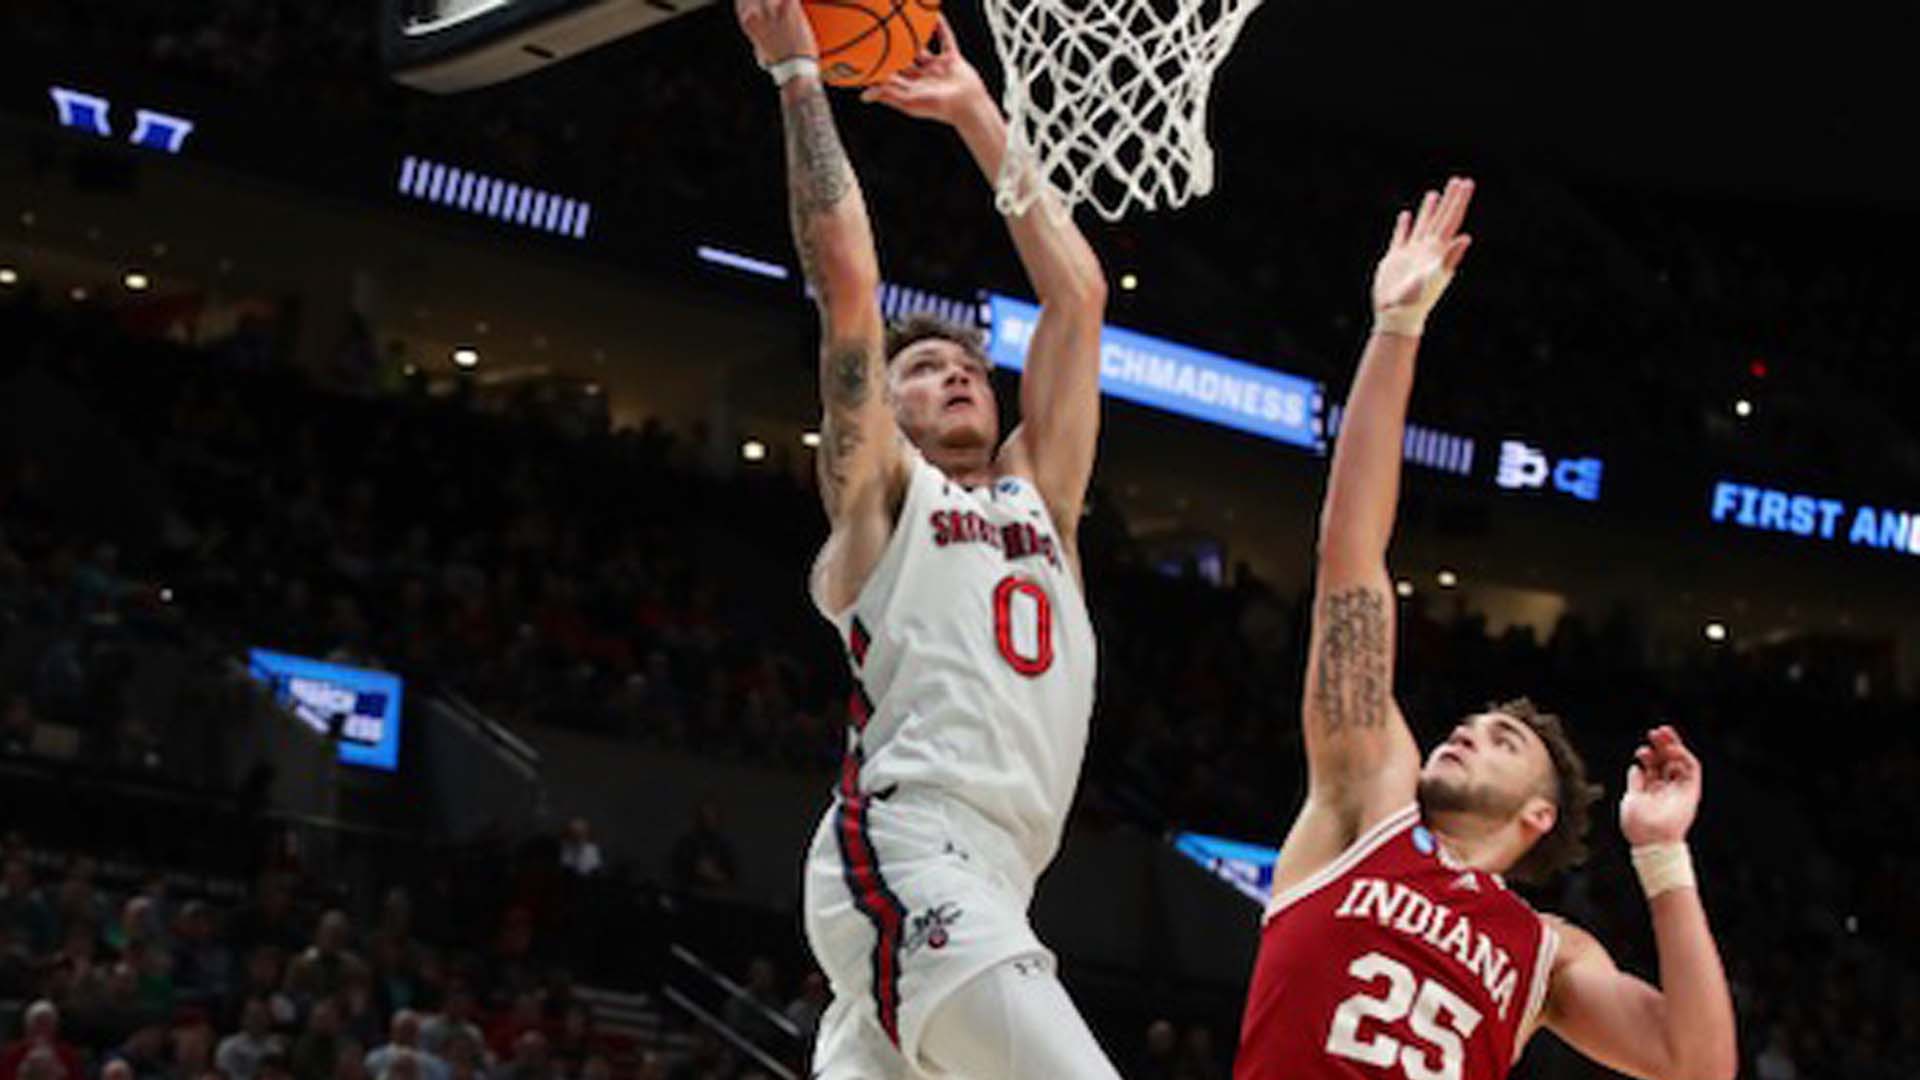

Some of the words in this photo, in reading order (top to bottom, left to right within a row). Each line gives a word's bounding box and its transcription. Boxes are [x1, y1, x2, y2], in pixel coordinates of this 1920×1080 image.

[1711, 481, 1844, 540] FIRST
[993, 575, 1055, 679] 0
[1335, 877, 1518, 1021] INDIANA
[1326, 951, 1484, 1080] 25
